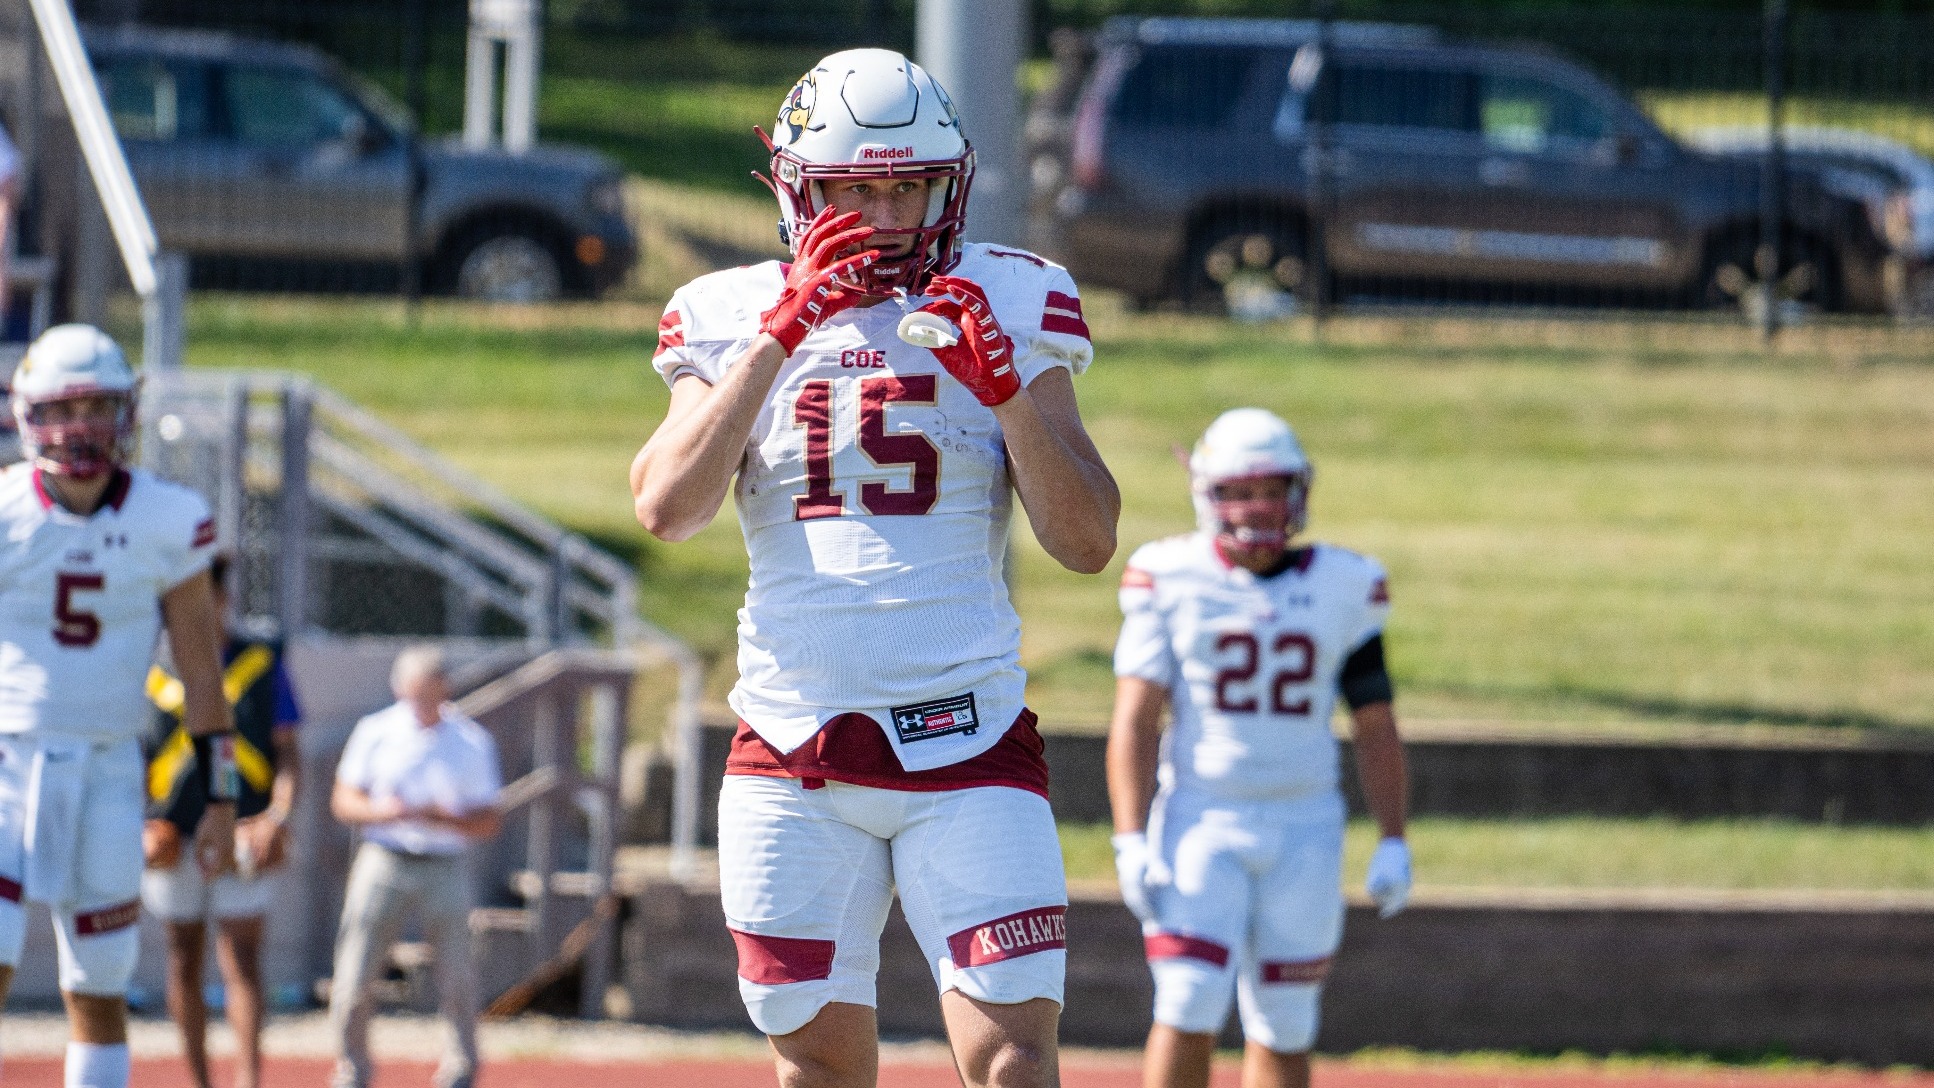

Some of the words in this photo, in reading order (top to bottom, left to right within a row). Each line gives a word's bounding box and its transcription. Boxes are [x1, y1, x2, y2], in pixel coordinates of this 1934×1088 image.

[863, 146, 914, 159] Riddell
[874, 267, 900, 275] Riddell
[840, 350, 886, 368] COE
[792, 372, 942, 521] 15
[53, 572, 104, 646] 5
[1214, 633, 1315, 715] 22
